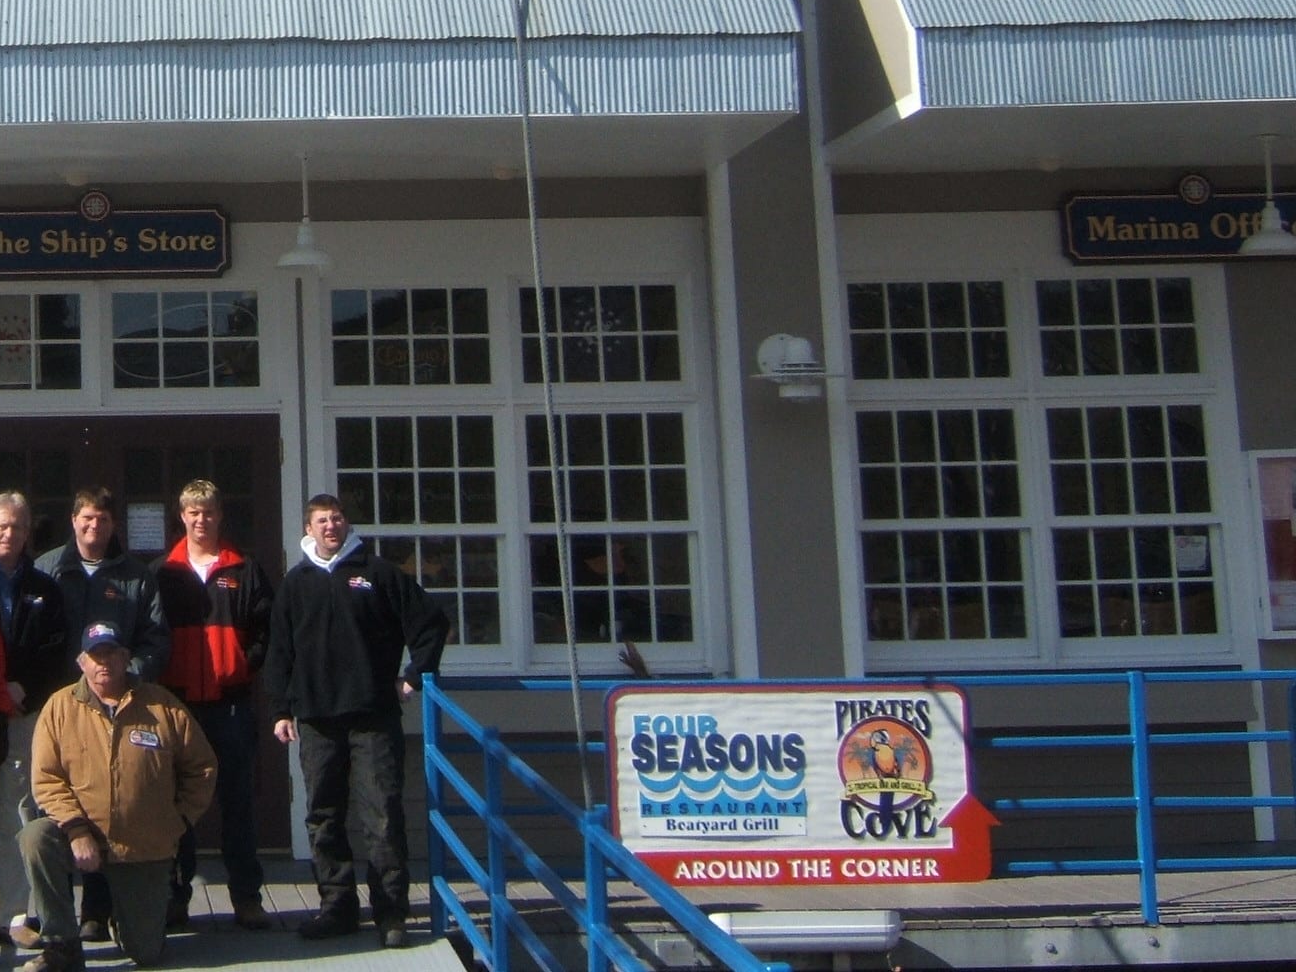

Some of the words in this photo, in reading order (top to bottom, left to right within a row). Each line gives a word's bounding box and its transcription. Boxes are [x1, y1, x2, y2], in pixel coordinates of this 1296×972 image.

[1087, 215, 1200, 241] Marina
[40, 229, 129, 258] Ship's
[138, 227, 216, 253] Store
[633, 715, 718, 738] FOUR
[835, 699, 933, 741] PIRATES
[631, 733, 807, 773] SEASONS
[642, 802, 803, 816] RESTAURANT
[840, 799, 938, 839] COVE
[743, 817, 779, 831] Grill
[674, 859, 780, 880] AROUND
[786, 859, 832, 879] THE
[841, 858, 940, 878] CORNER
